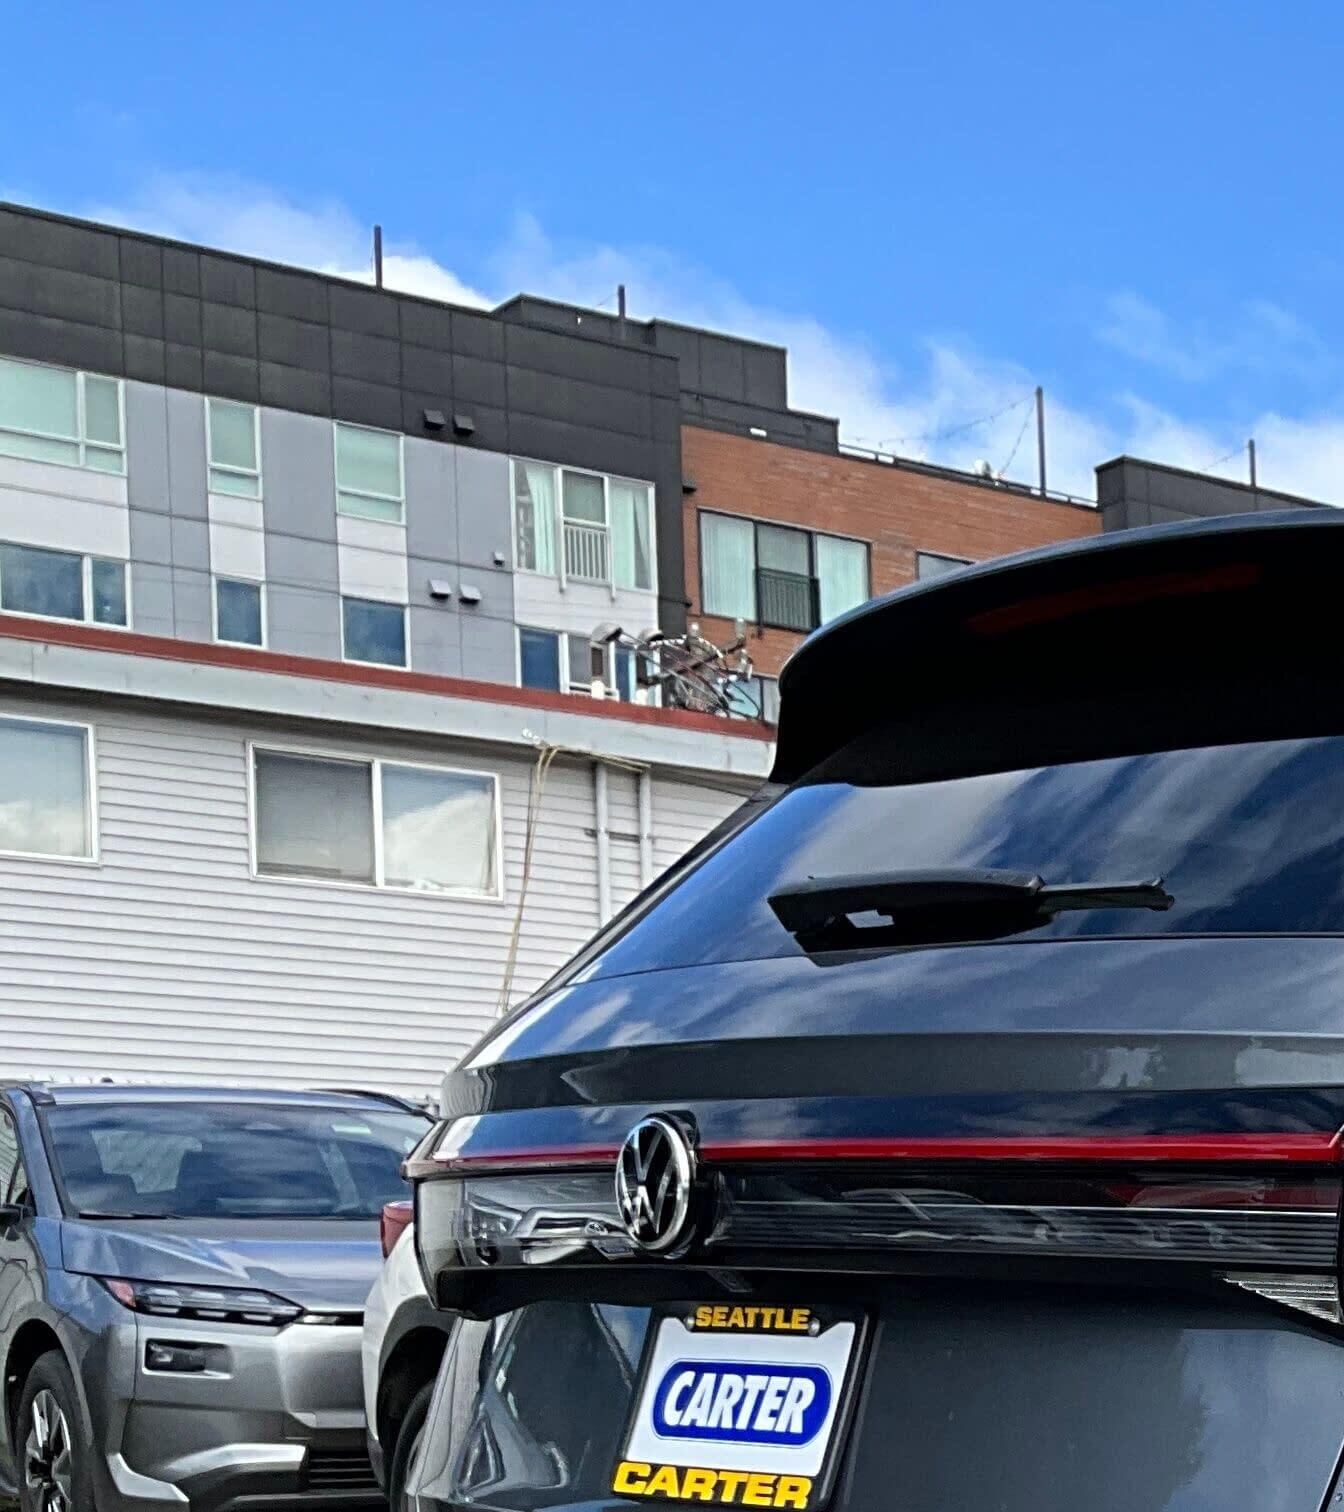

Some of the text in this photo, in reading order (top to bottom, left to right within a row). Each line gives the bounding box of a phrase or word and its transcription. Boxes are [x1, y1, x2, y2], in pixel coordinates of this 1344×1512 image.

[695, 1305, 812, 1331] SEATTLE
[663, 1370, 816, 1434] CARTER
[612, 1461, 813, 1510] CARTER
